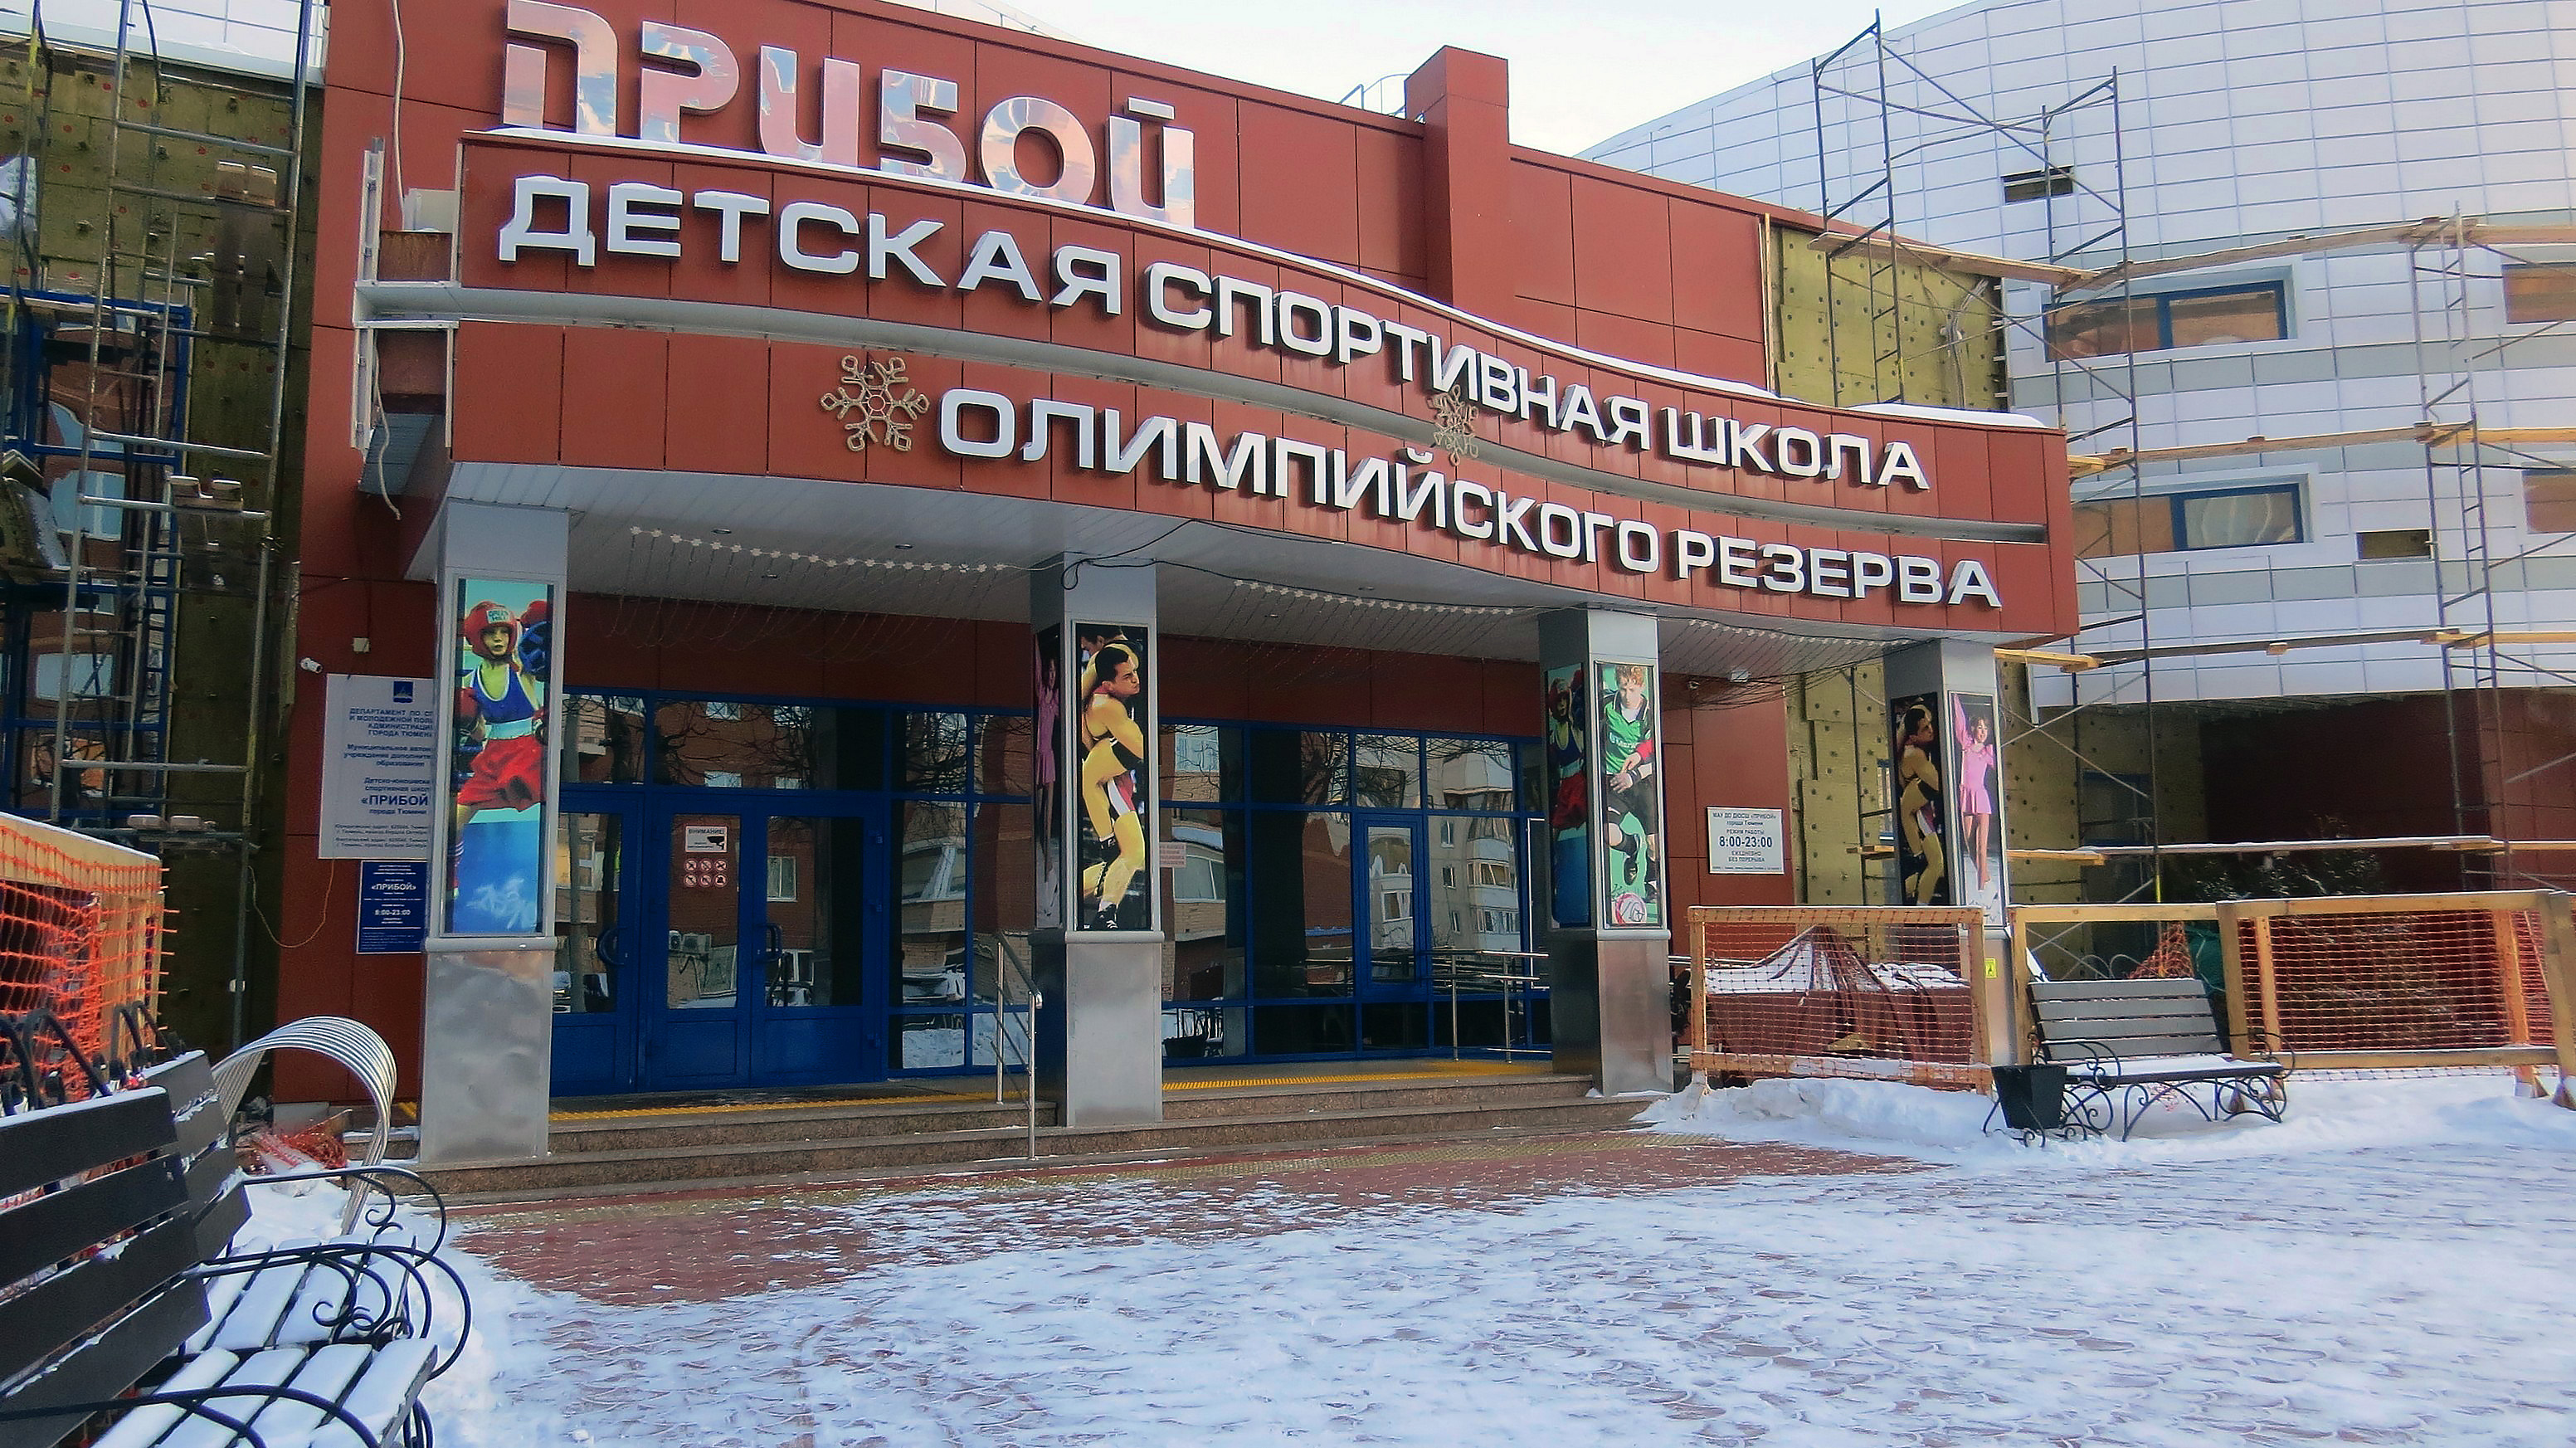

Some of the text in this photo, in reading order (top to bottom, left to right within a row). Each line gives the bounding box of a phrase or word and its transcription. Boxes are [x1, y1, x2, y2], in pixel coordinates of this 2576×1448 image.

[499, 175, 1931, 491] ДЕТСКАЯ СПОРТИВНАЯ ШКОЛА
[939, 388, 2003, 609] ОЛИМПИЙСКОГО РЕЗЕРВА
[361, 793, 428, 805] «ПРИБОЙ
[1719, 836, 1773, 847] 8:00-23:00
[372, 882, 416, 890] «ПРИБОЙ»
